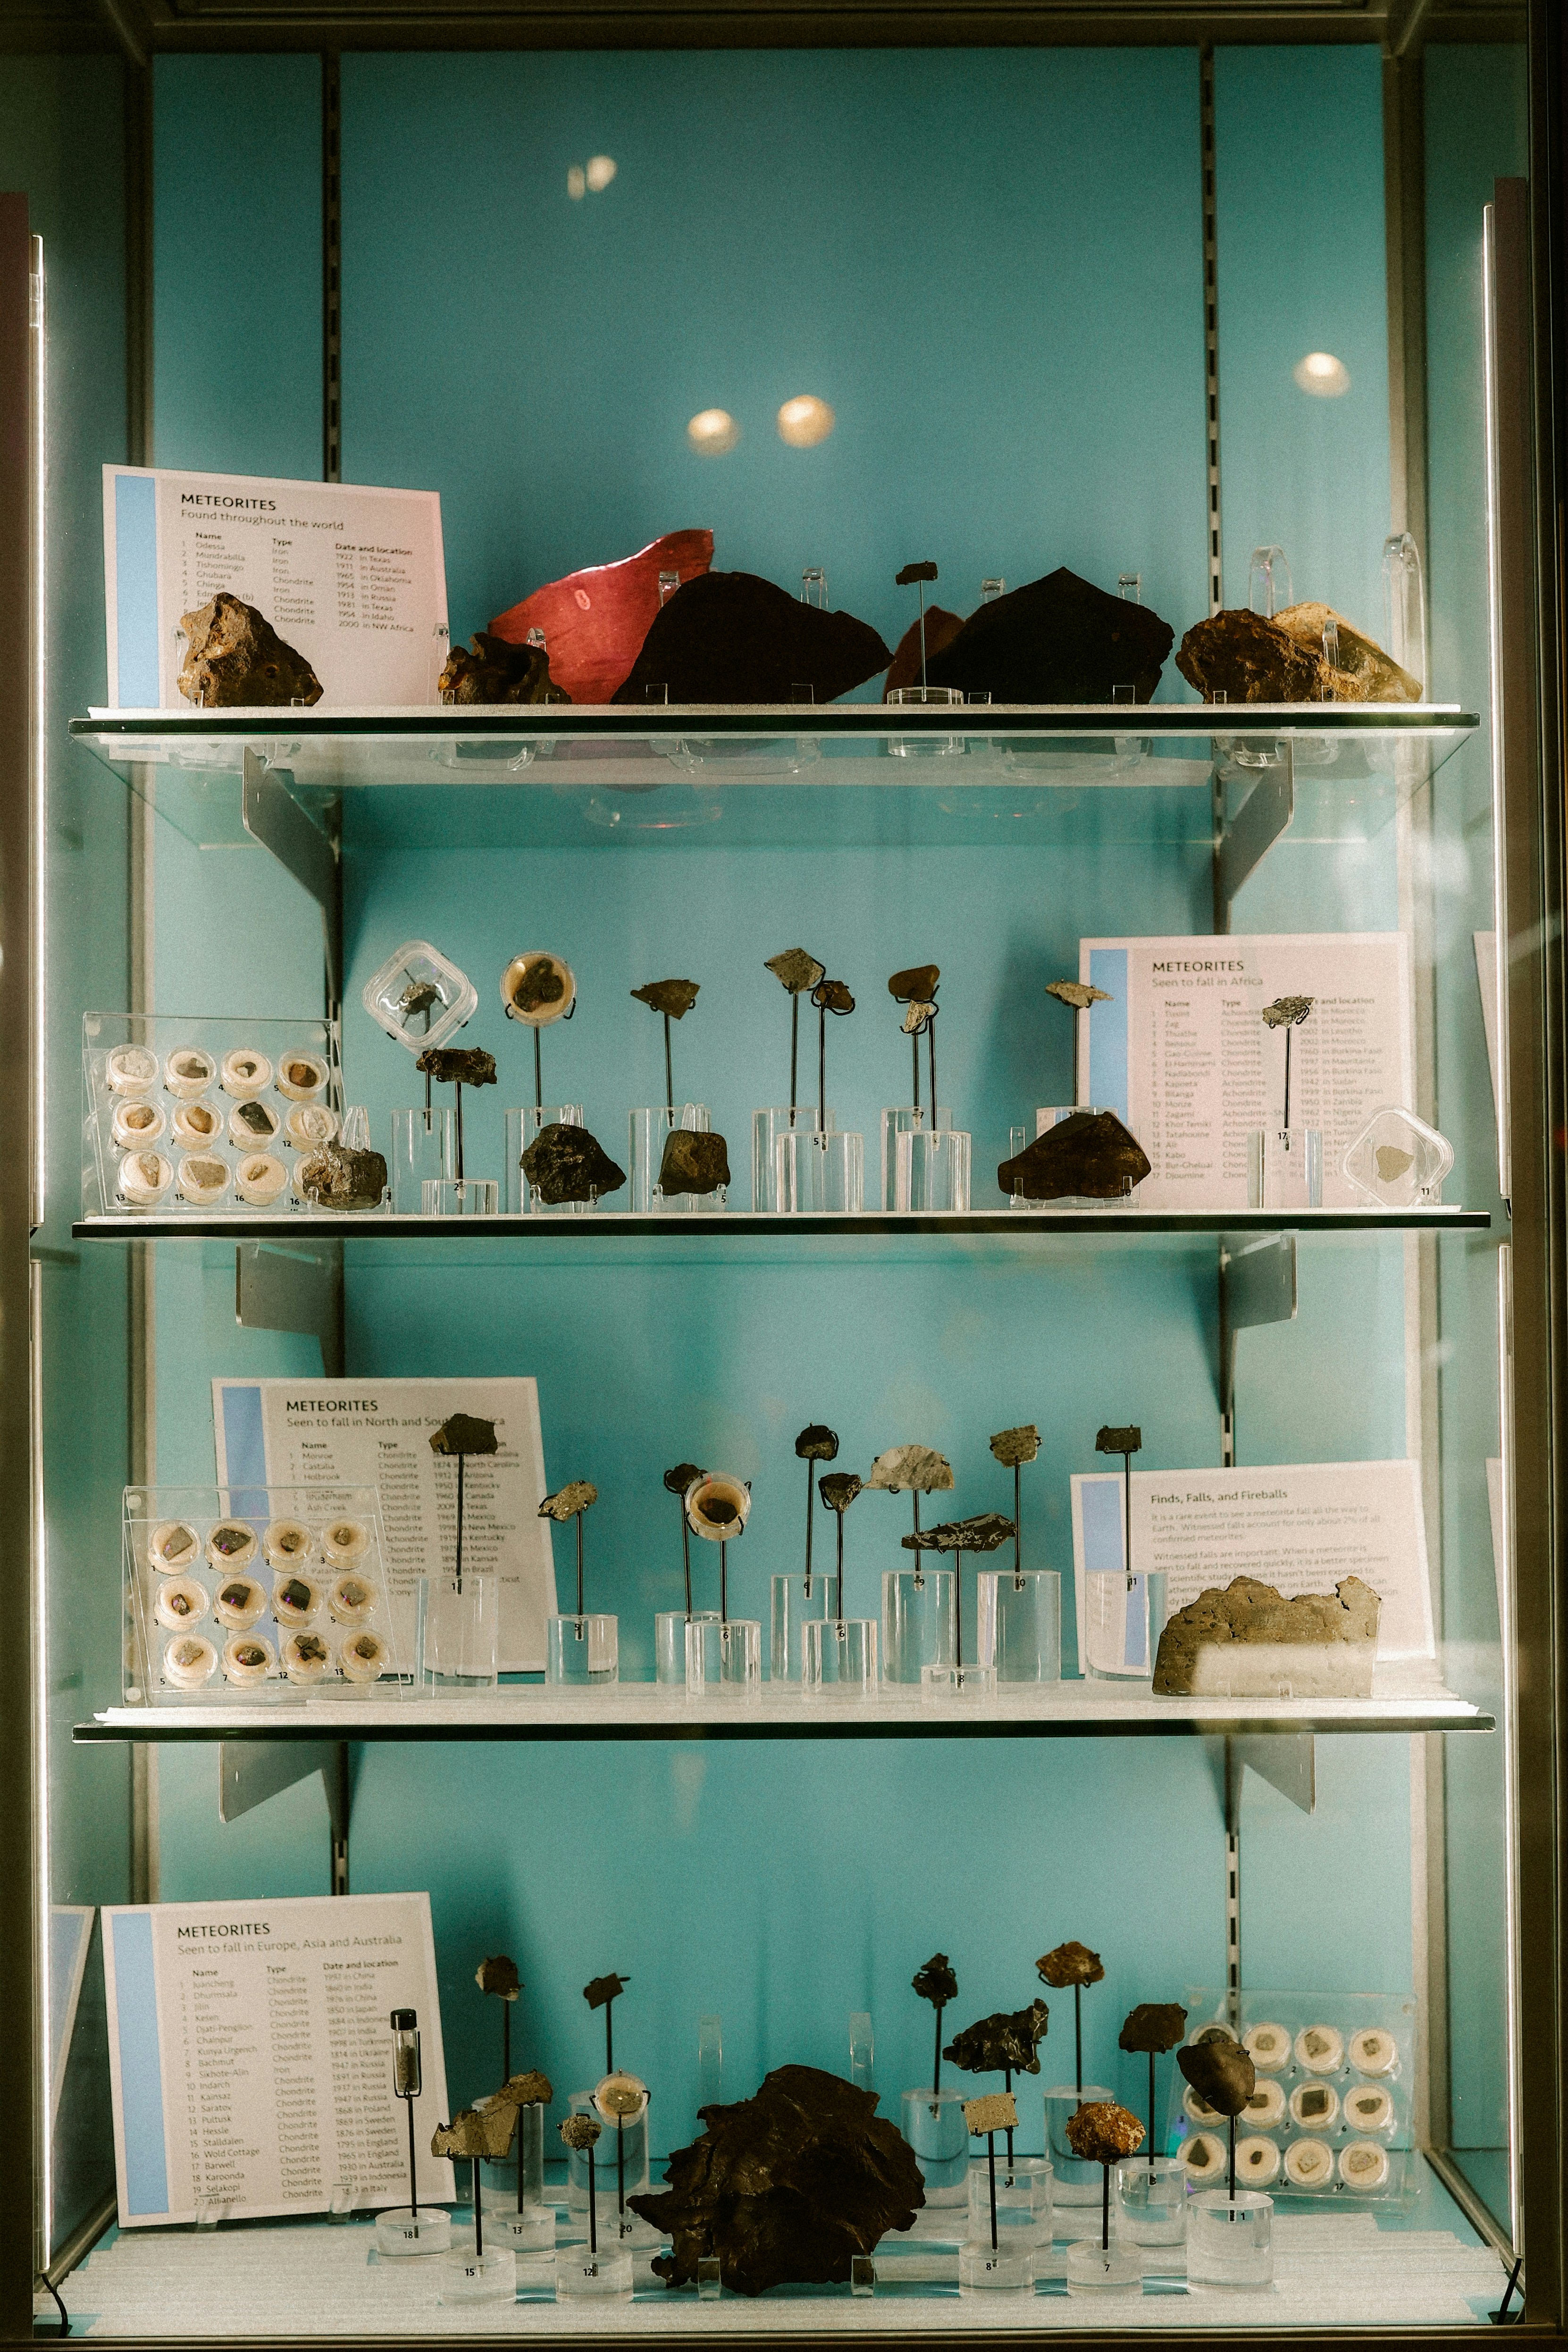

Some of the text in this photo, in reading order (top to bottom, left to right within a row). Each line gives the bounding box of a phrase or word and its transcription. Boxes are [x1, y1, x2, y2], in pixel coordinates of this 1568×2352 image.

[182, 494, 276, 511] METEORITES
[181, 509, 344, 530] Found throughout the world
[273, 538, 292, 546] Type
[377, 547, 412, 555] location
[275, 615, 315, 624] Chondrite
[1153, 961, 1244, 972] METEORITES
[1152, 978, 1178, 987] Seen
[1197, 977, 1214, 986] fall
[1230, 978, 1263, 986] Africa
[287, 1401, 378, 1412] METEORITES
[287, 1418, 313, 1427] Seen
[332, 1417, 349, 1426] fall
[366, 1418, 398, 1426] North
[1151, 1490, 1287, 1504] Finds, Falls, and Fireballs
[178, 1923, 270, 1938] METEORITES
[178, 1936, 402, 1955] Seen to fall in Europe, Asia and Australia
[204, 2150, 225, 2158] Wold
[227, 2149, 260, 2157] Cottage
[367, 2138, 398, 2148] England
[205, 2161, 235, 2170] Barwell
[368, 2150, 399, 2159] England
[206, 2172, 244, 2181] Karoonda
[281, 2168, 320, 2176] Chondrite
[282, 2179, 322, 2187] Chondrite
[283, 2190, 322, 2199] Chondrite
